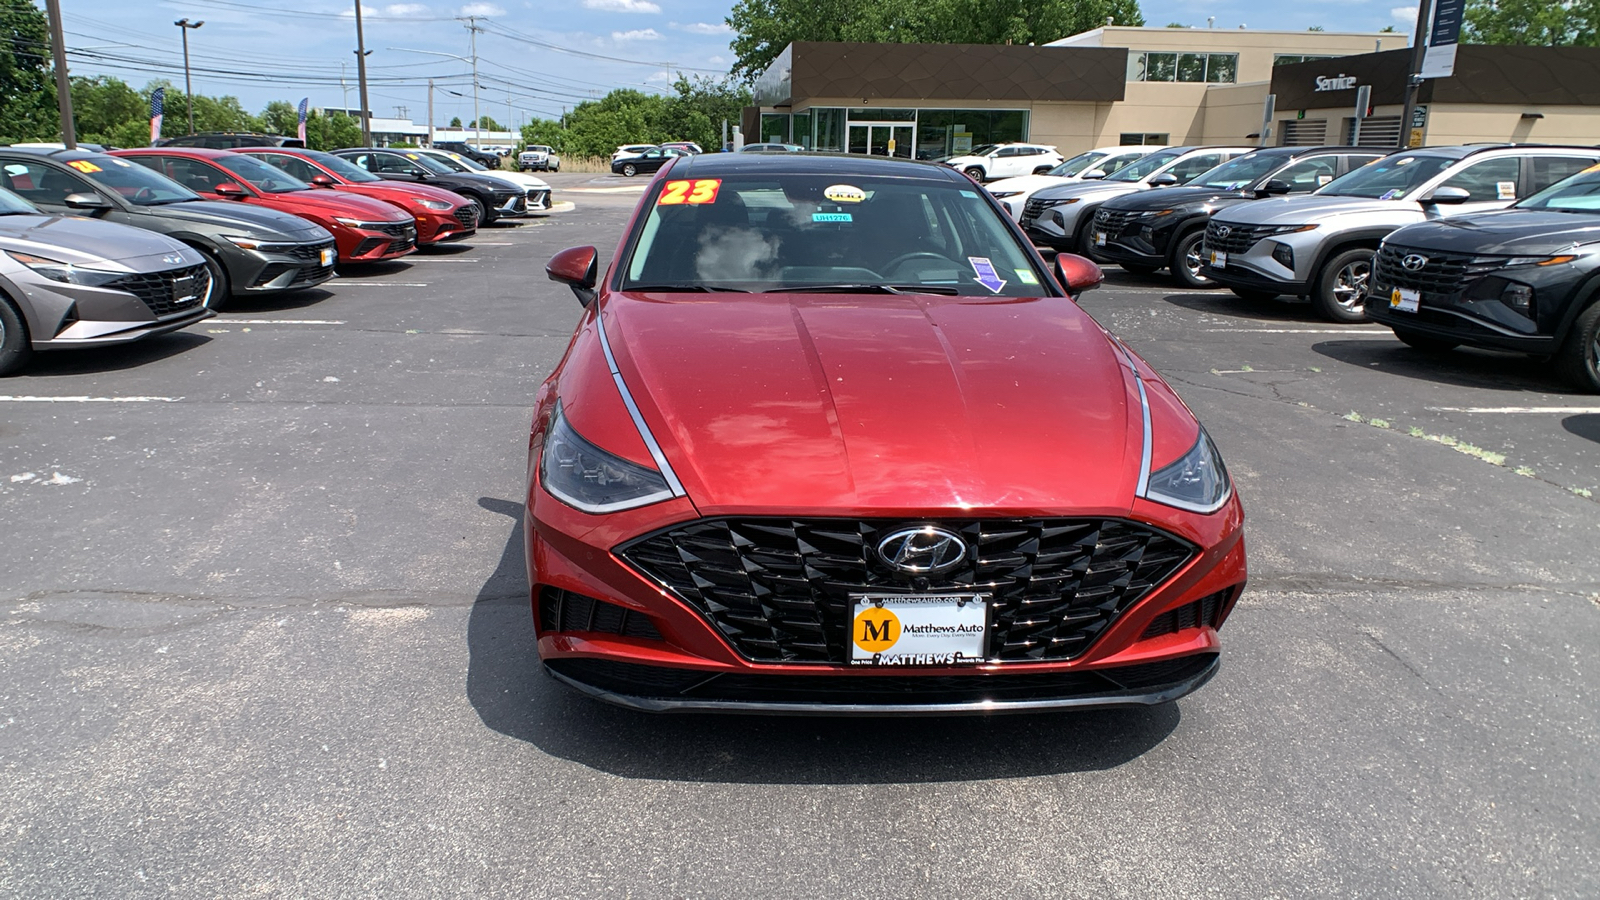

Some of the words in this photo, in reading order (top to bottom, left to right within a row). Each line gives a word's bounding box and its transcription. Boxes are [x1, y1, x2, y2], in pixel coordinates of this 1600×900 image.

[1315, 73, 1357, 92] Service
[660, 179, 719, 204] 23
[882, 596, 962, 604] MatthewsAuto.com
[860, 620, 893, 642] M
[903, 623, 956, 634] Matthews
[956, 623, 984, 633] Auto
[878, 653, 956, 666] MATTHEWS
